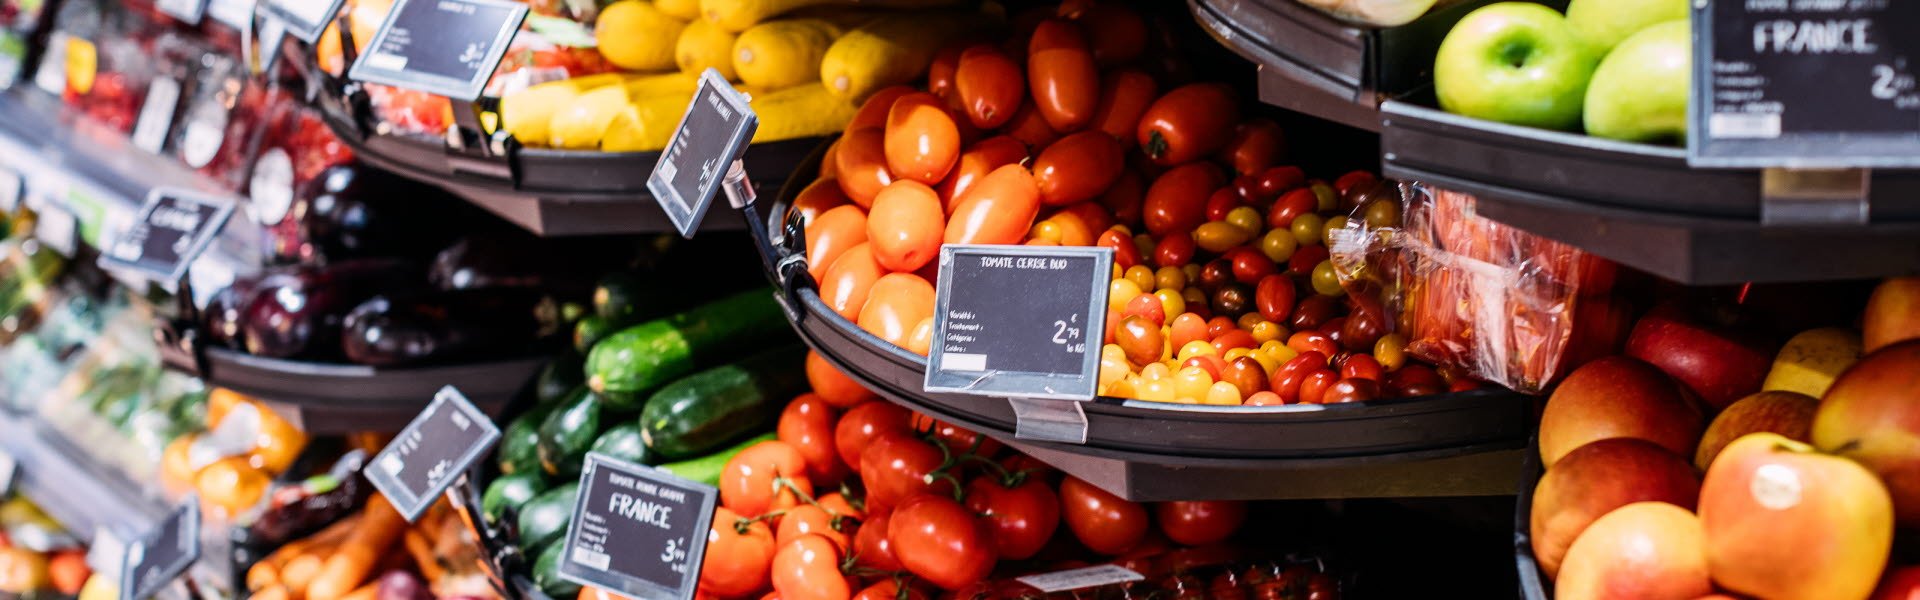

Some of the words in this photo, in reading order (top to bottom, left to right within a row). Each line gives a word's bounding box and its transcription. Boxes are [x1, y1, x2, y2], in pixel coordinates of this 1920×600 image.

[1753, 18, 1879, 54] FRANCE
[1871, 64, 1897, 99] 2
[981, 256, 1014, 268] TOMATE
[1016, 257, 1047, 270] CERISE
[608, 492, 672, 530] FRANCE
[660, 538, 676, 563] 3
